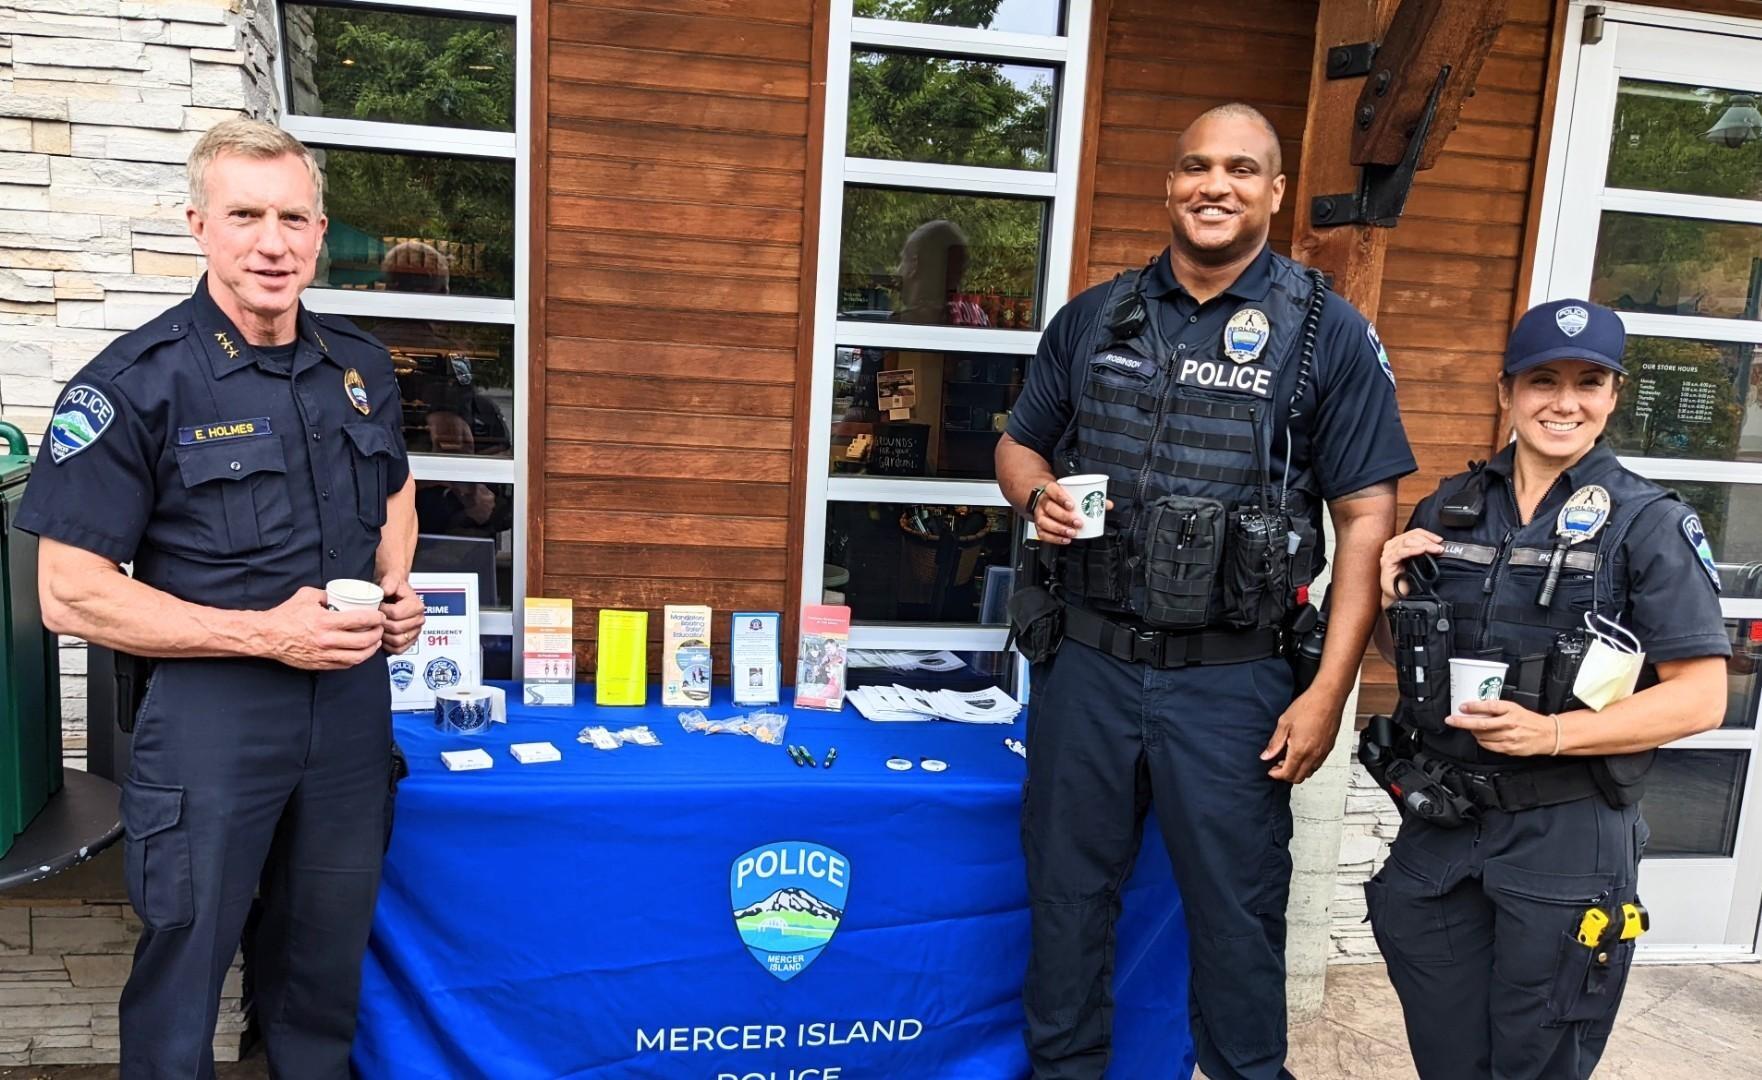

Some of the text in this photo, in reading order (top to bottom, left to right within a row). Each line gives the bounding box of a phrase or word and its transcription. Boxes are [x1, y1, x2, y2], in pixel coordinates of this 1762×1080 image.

[1558, 308, 1587, 319] POLICE
[1105, 353, 1143, 369] ROBINSON
[1657, 364, 1676, 372] STORE
[1180, 359, 1272, 395] POLICE
[63, 389, 111, 425] POLICE
[208, 423, 254, 438] HOLMES
[1538, 553, 1573, 563] POE
[427, 635, 449, 646] 911
[736, 848, 845, 888] POLICE
[768, 954, 805, 964] MERCER
[769, 962, 802, 972] ISLAND
[636, 1018, 924, 1052] MERCER ISLAND
